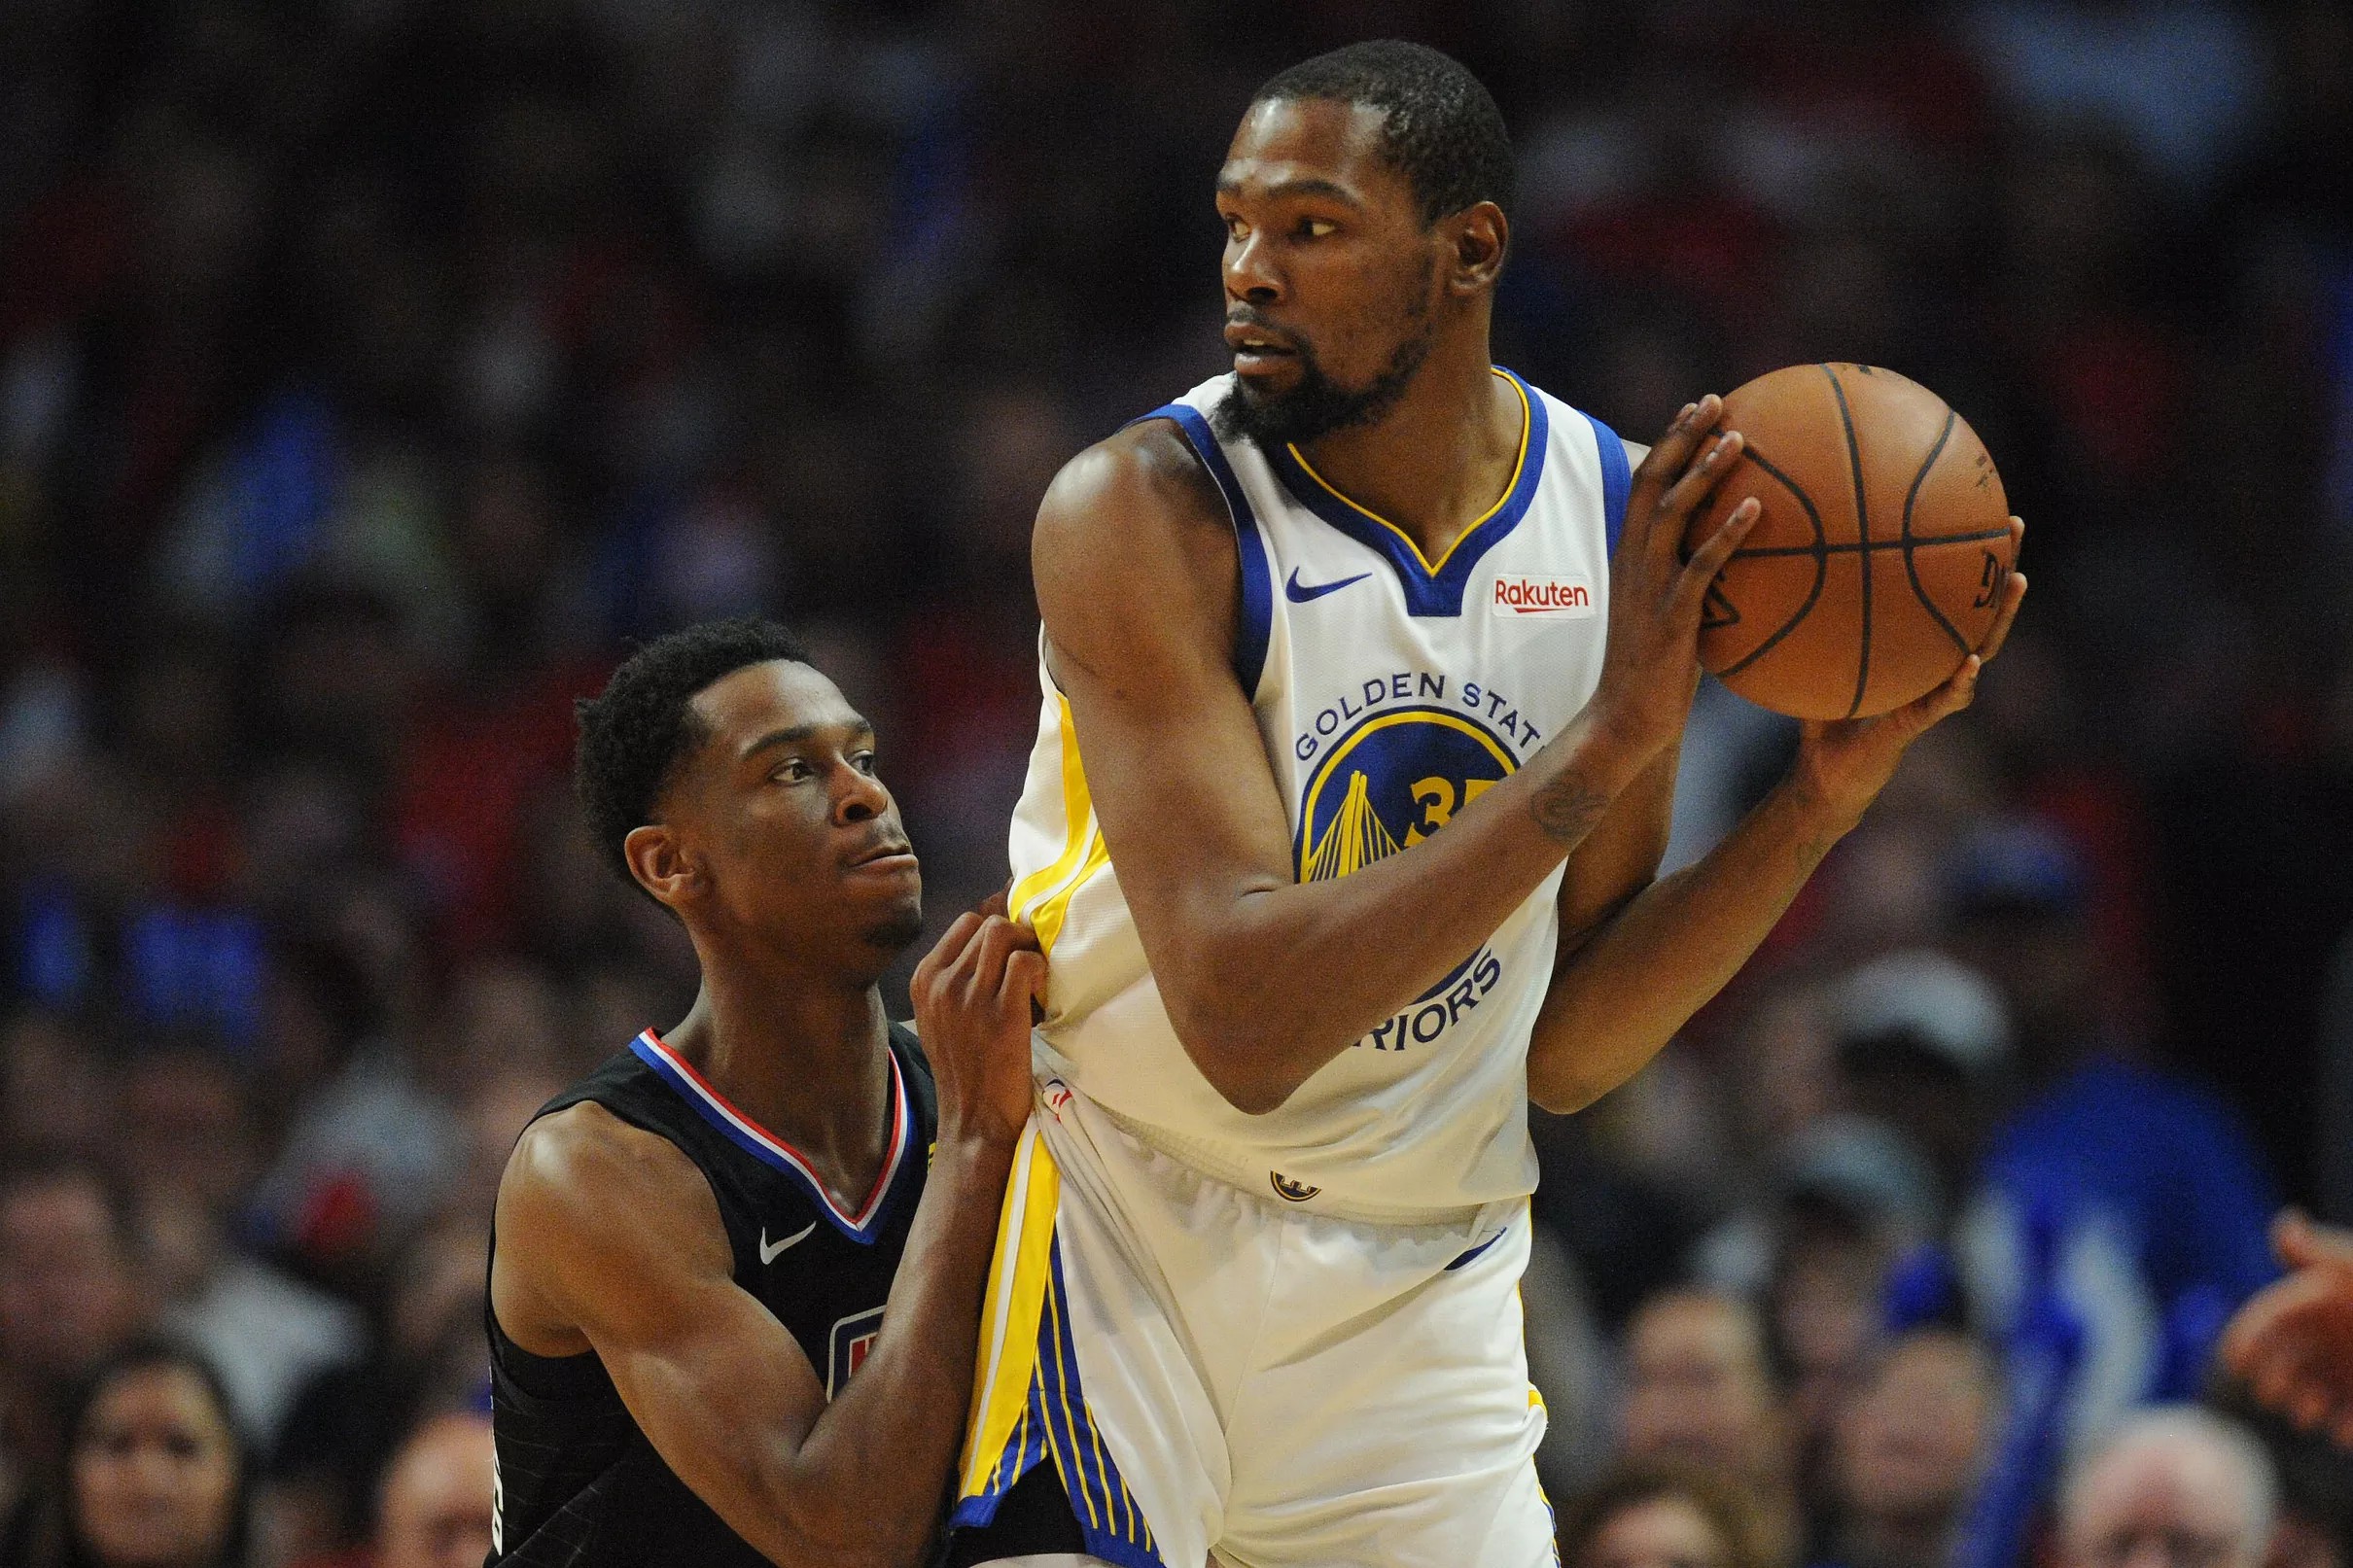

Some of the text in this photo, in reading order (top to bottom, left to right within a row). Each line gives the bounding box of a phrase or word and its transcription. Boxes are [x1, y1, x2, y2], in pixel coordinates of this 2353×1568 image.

[1494, 578, 1590, 608] Rakuten
[1295, 672, 1545, 762] GOLDEN STAT
[1352, 948, 1501, 1052] RIORS
